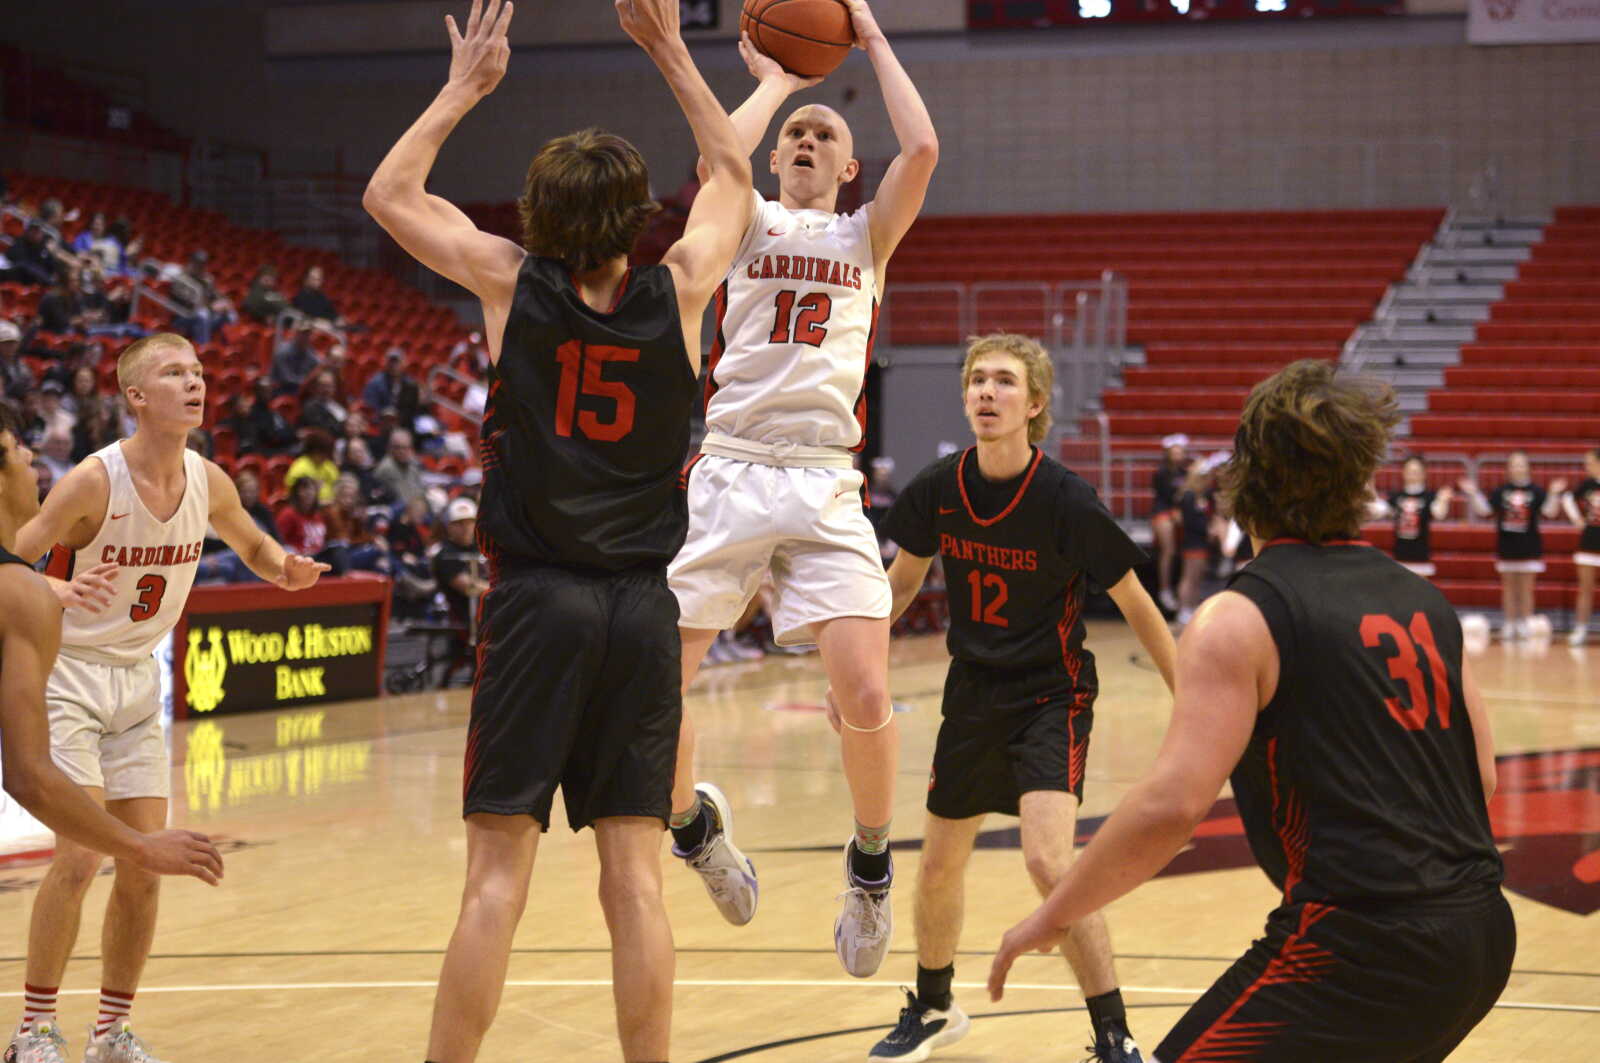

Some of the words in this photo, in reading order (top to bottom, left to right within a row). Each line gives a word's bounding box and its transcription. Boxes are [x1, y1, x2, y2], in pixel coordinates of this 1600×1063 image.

[746, 254, 862, 290] CARDINALS
[768, 289, 832, 348] 12
[555, 338, 641, 442] 15
[101, 541, 202, 567] CARDINALS
[940, 533, 1038, 571] PANTHERS
[129, 573, 167, 623] 3
[967, 569, 1009, 628] 12
[227, 629, 284, 664] WOOD
[285, 625, 303, 660] &
[275, 664, 326, 700] BANK
[1359, 612, 1451, 731] 31
